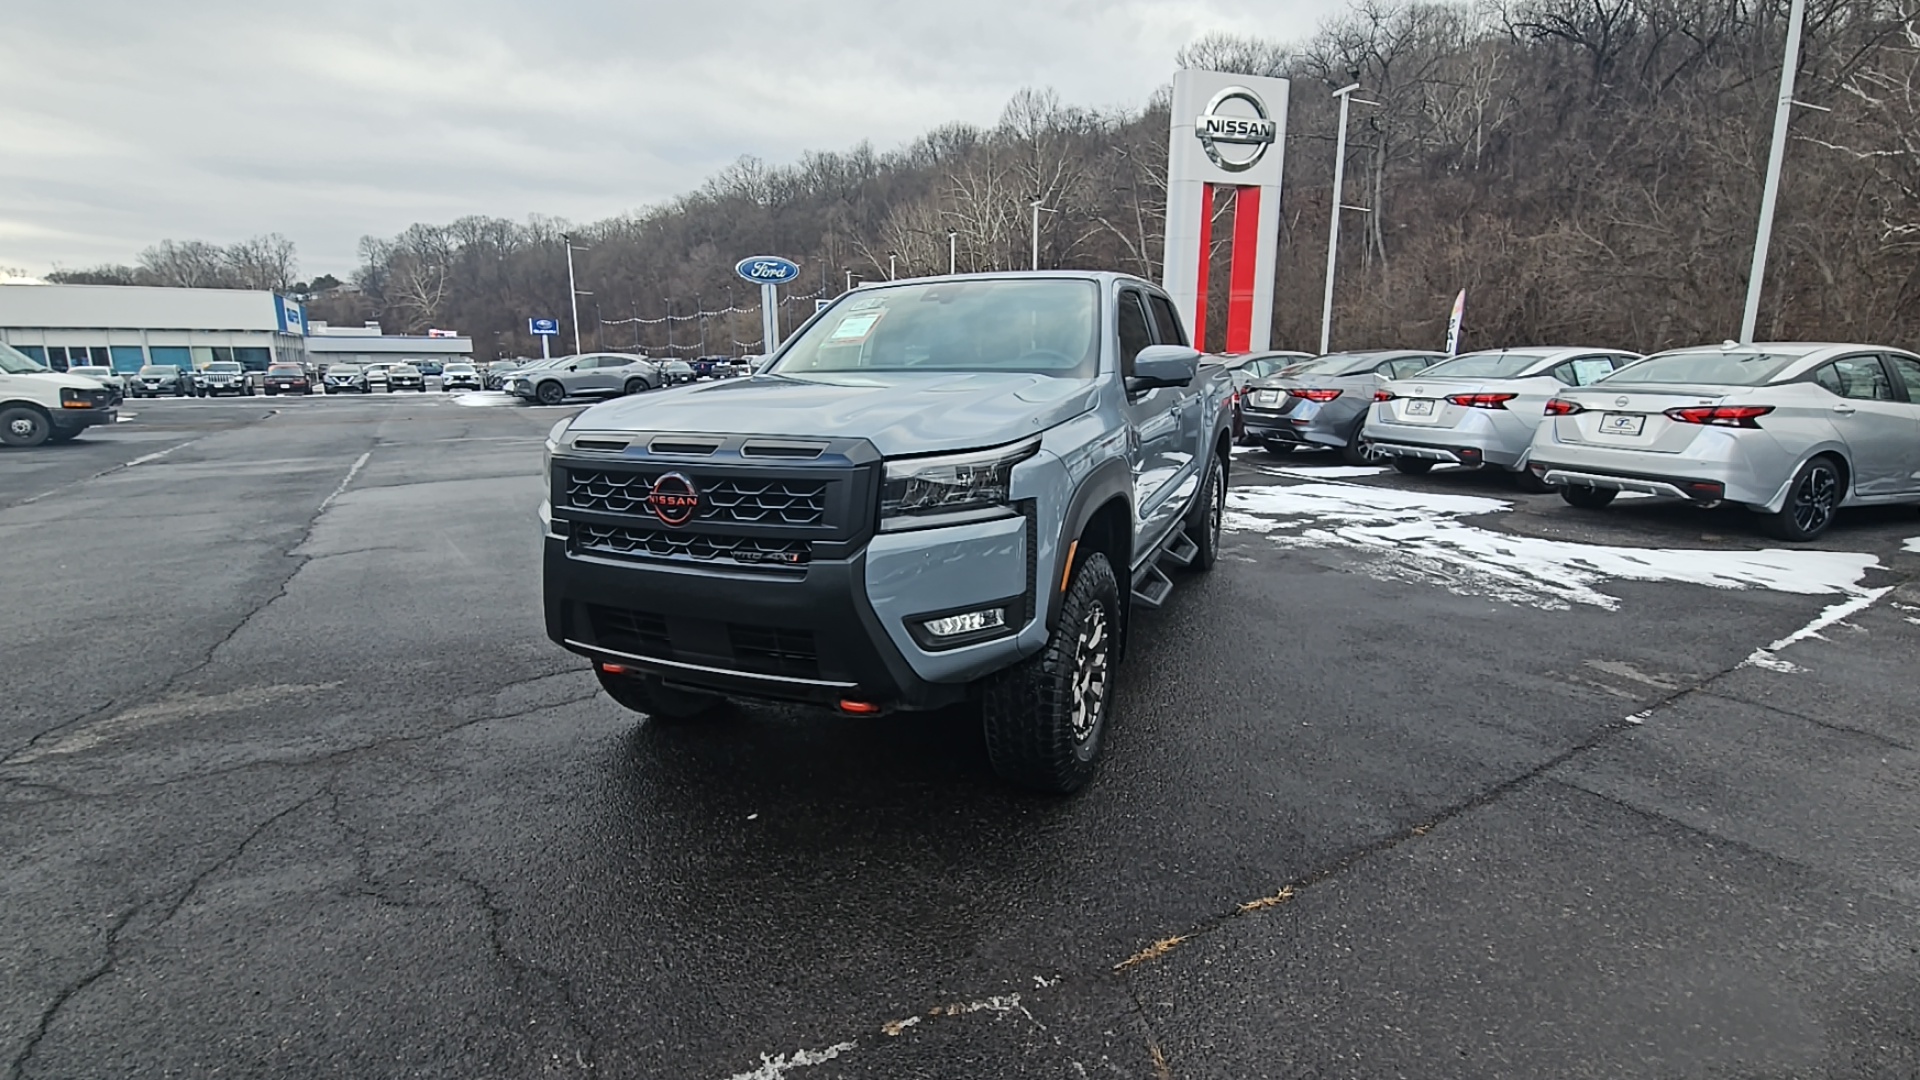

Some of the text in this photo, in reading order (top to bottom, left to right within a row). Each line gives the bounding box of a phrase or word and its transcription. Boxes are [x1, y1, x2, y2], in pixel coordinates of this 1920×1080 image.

[1206, 119, 1271, 137] NISSAN
[751, 261, 787, 278] Ford
[649, 495, 698, 506] NISSAN
